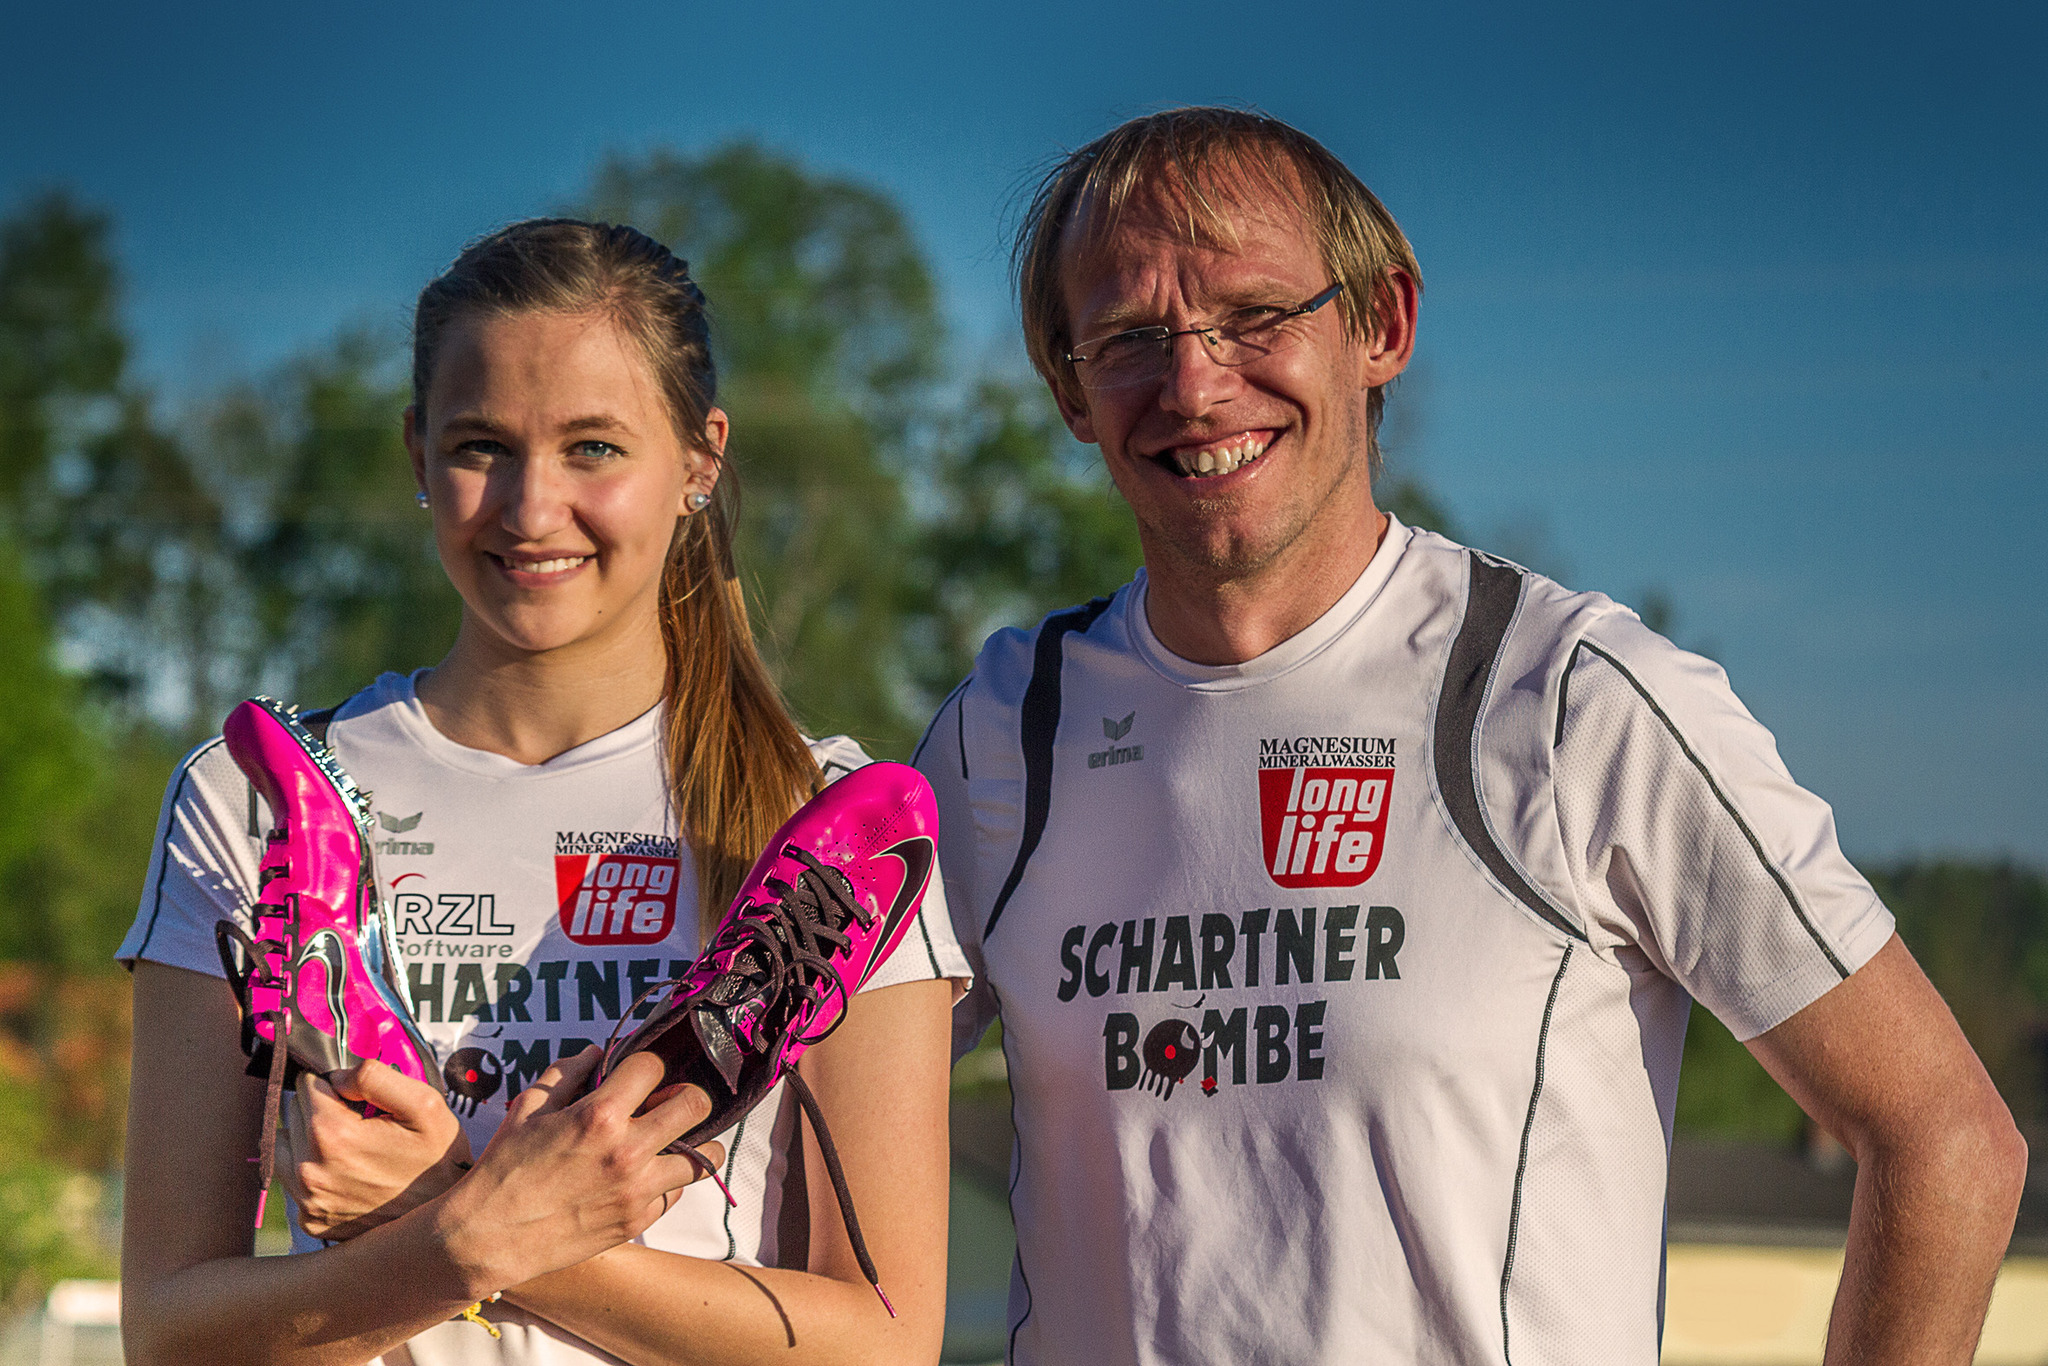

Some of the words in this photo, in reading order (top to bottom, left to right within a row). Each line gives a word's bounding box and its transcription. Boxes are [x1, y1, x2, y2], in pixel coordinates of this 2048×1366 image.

[1087, 743, 1144, 769] erima
[1259, 737, 1396, 756] MAGNESIUM
[1259, 754, 1396, 768] MINERALWASSER
[1286, 768, 1387, 822] long
[375, 838, 434, 855] rima
[1272, 815, 1373, 876] life
[581, 853, 675, 895] long
[394, 893, 515, 936] RZL
[569, 889, 665, 936] life
[1057, 905, 1405, 1003] SCHARTNER
[406, 958, 695, 1023] HARTNE
[1103, 1001, 1327, 1101] BOMBE
